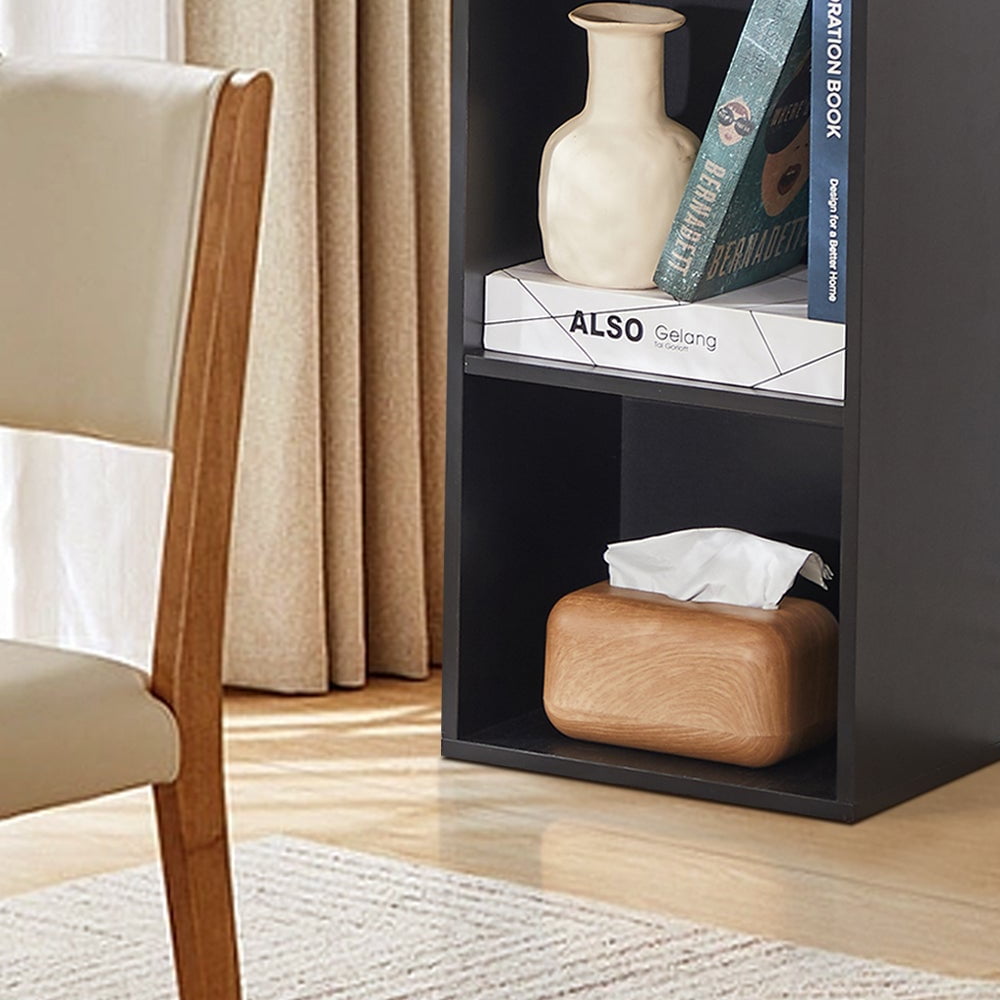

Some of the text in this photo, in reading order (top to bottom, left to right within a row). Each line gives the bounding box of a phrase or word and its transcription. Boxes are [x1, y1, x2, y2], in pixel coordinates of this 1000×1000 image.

[826, 79, 842, 140] BOOK
[828, 178, 839, 212] Design
[829, 214, 839, 229] for
[829, 240, 838, 270] Better
[828, 271, 838, 302] Home
[570, 310, 717, 352] ALSO Gelang
